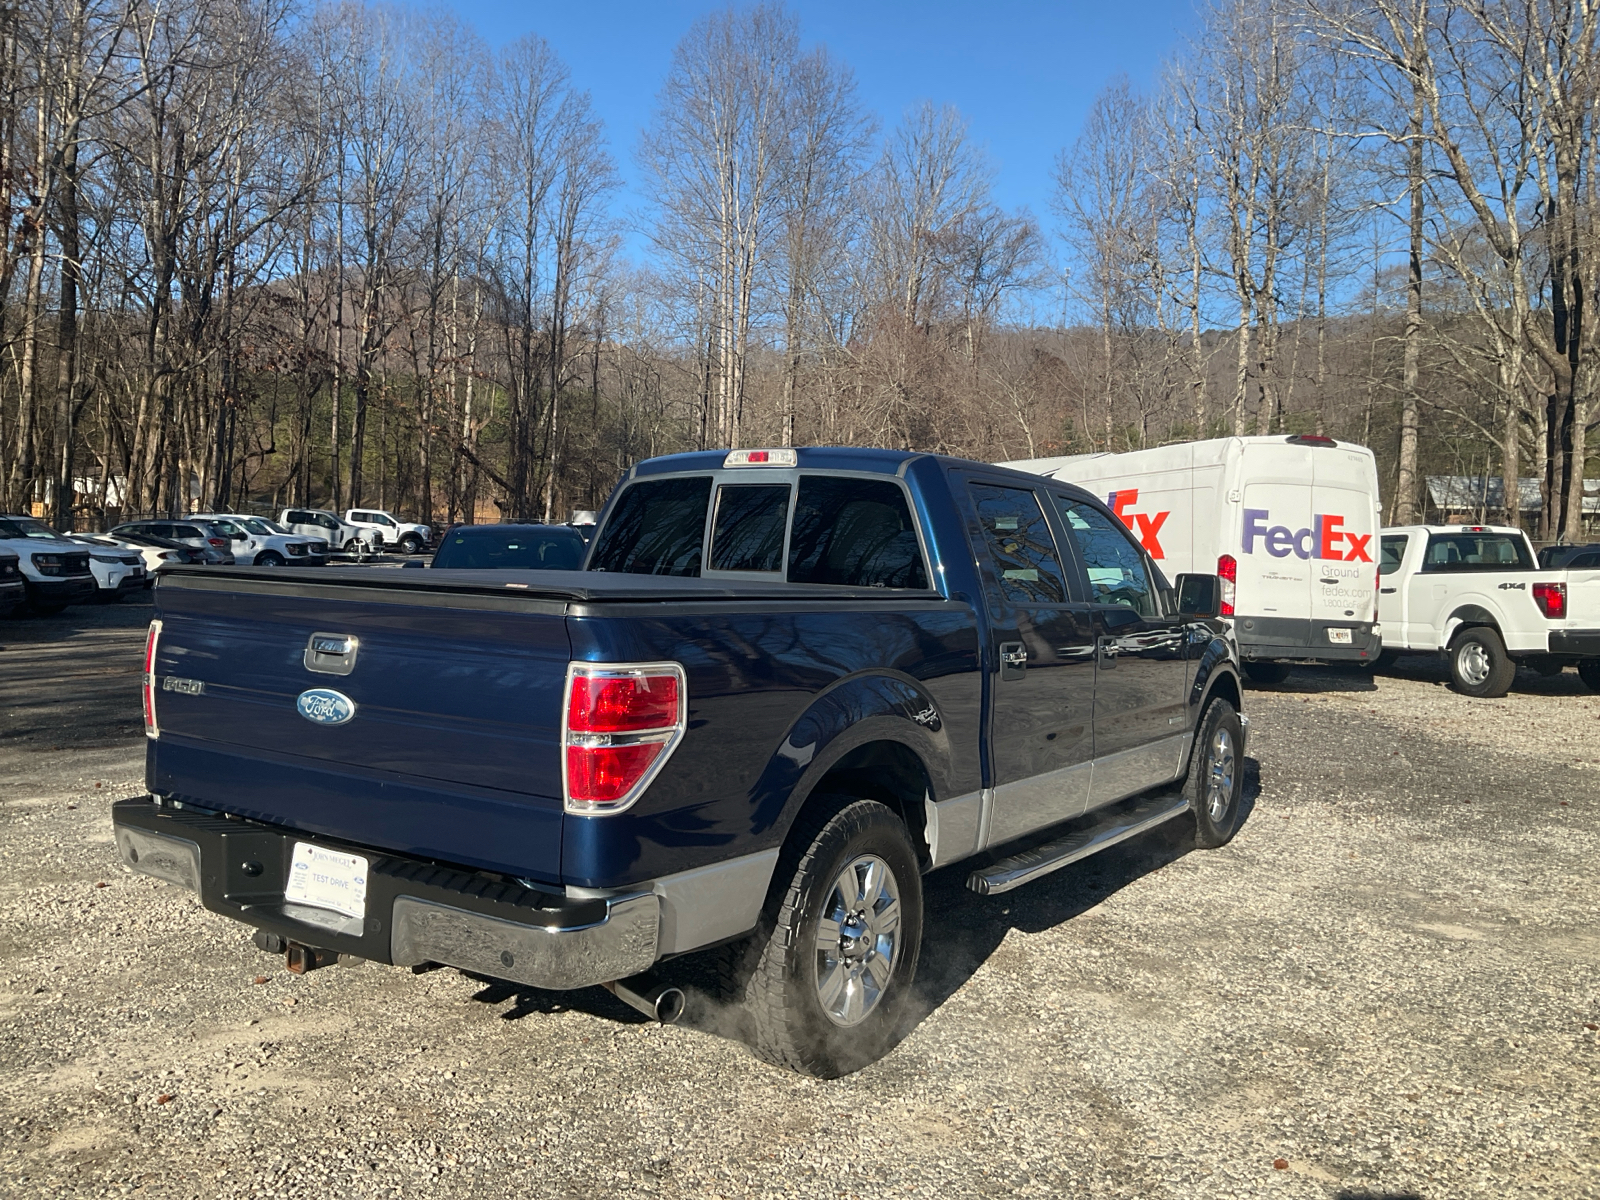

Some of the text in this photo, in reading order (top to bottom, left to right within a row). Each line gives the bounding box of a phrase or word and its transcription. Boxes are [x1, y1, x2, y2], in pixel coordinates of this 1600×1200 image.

[1242, 508, 1373, 563] FedEx
[1321, 565, 1359, 578] Ground
[1321, 585, 1371, 598] fedex.com
[305, 695, 336, 717] Ford
[312, 873, 329, 884] TEST
[330, 877, 349, 890] DRIVE
